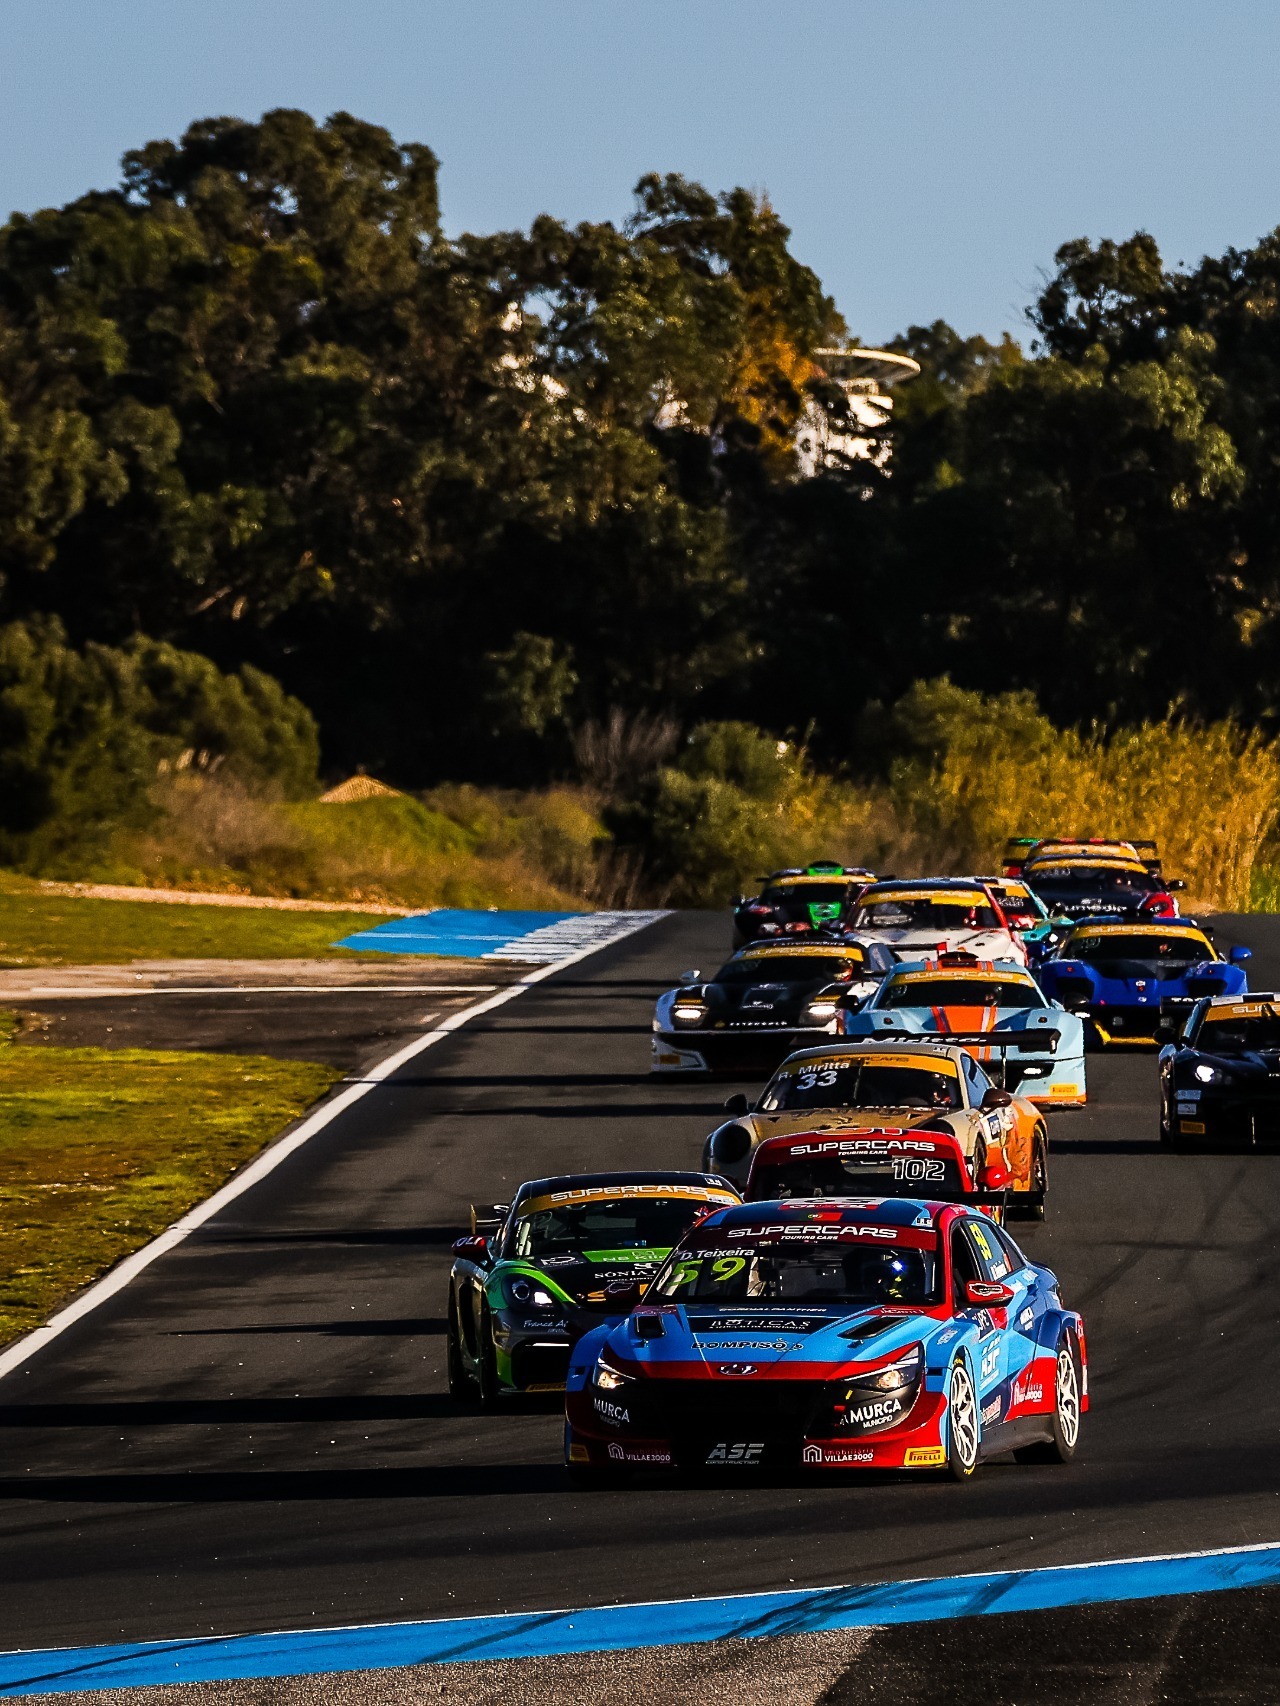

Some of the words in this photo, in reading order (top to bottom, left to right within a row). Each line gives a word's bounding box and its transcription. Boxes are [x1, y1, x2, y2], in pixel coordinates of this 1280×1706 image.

[799, 1062, 850, 1076] Miritta
[797, 1071, 838, 1090] 33
[790, 1140, 936, 1156] SUPERCARS
[892, 1159, 946, 1181] 102
[550, 1185, 709, 1202] SUPERCARS
[726, 1224, 898, 1239] SUPERCARS
[696, 1248, 755, 1259] Teixeira
[666, 1256, 746, 1287] 59
[708, 1443, 764, 1459] ASF
[909, 1450, 941, 1461] PIRELLI
